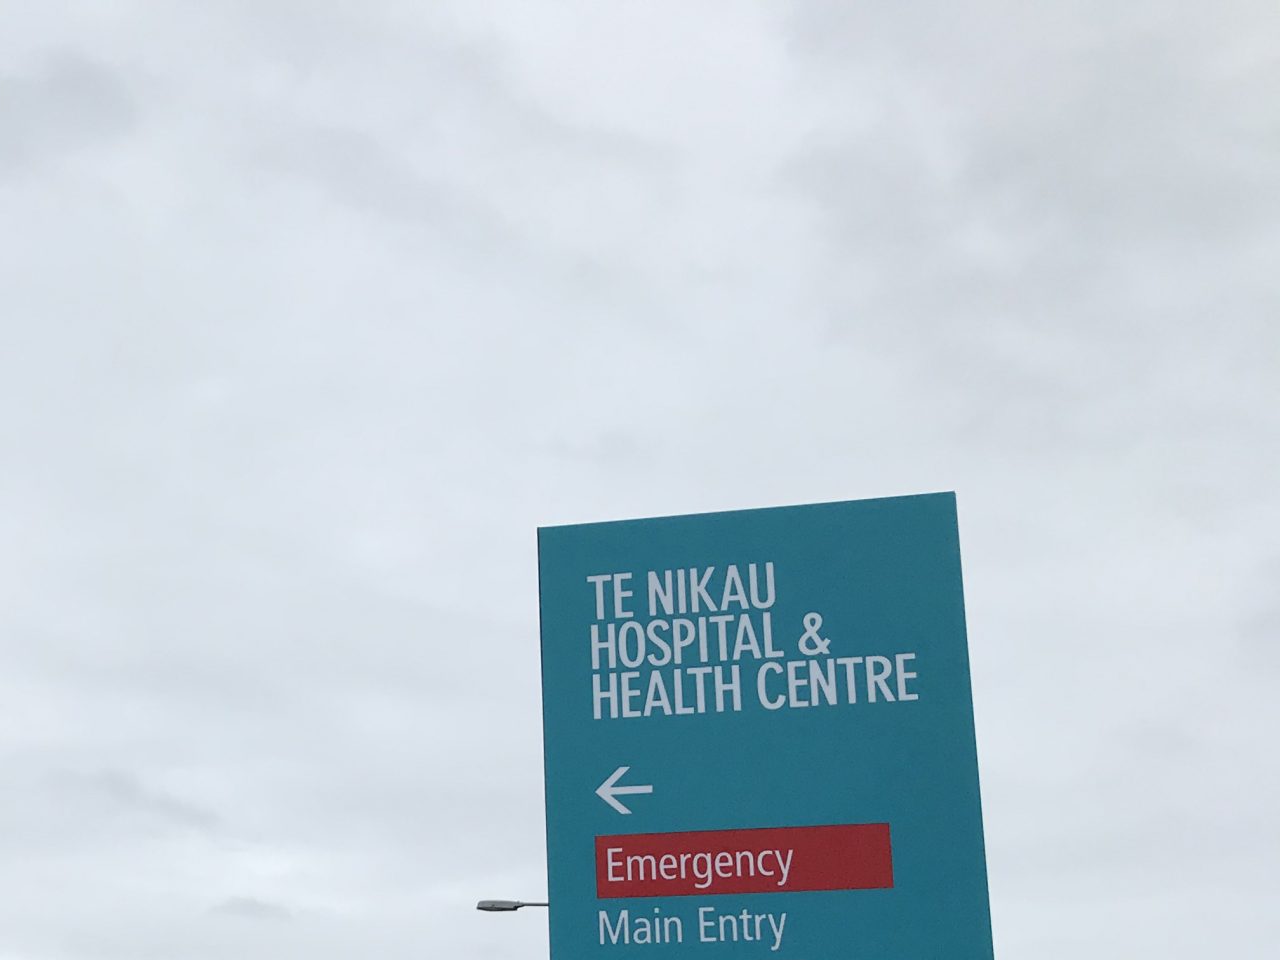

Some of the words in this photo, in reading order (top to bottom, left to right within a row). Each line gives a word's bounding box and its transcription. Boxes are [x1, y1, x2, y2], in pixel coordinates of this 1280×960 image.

[586, 572, 634, 620] TE
[647, 561, 776, 617] NIKAU
[590, 611, 785, 670] HOSPITAL
[797, 612, 831, 656] &
[592, 664, 742, 720] HEALTH
[756, 652, 919, 710] CENTRE
[606, 847, 794, 889] Emergency
[598, 907, 683, 945] Main
[698, 906, 787, 951] Entry
